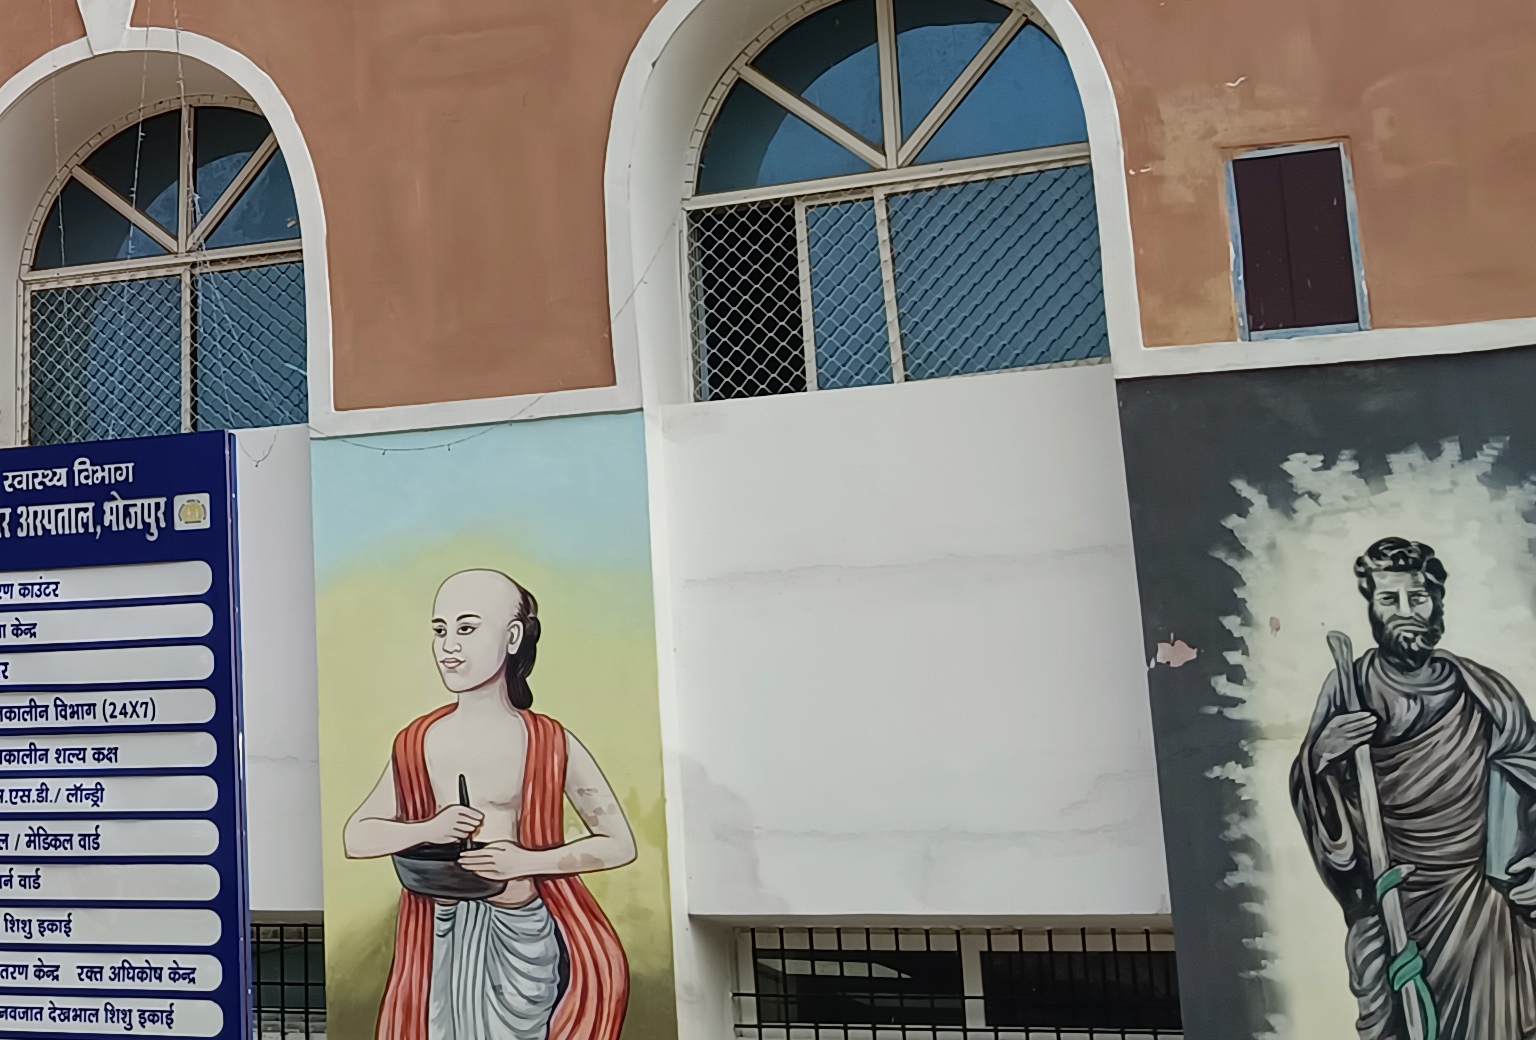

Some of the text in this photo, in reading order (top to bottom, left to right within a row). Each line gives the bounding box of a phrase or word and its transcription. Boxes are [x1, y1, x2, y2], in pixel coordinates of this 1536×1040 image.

[3, 458, 134, 491] स्वास्थ्य विभाग
[18, 576, 60, 598] काउंटर
[11, 617, 37, 638] केन्द्र
[54, 697, 97, 721] विभाग
[103, 697, 155, 722] (24X7)
[55, 748, 87, 764] शल्य
[91, 747, 118, 763] कक्ष
[66, 782, 105, 807] लॉन्ड्री
[25, 826, 74, 850] मेडिकल
[78, 825, 100, 850] वार्ड
[18, 868, 41, 889] वार्ड
[4, 913, 32, 939] शिशु
[36, 913, 72, 937] इकाई
[33, 958, 60, 981] केन्द्र
[76, 966, 104, 981] रक्त
[109, 959, 163, 982] अधिकोष
[168, 960, 196, 984] केन्द्र
[48, 1000, 100, 1023] देखभाल
[104, 1002, 133, 1031] शिशु
[137, 1003, 174, 1029] इकाई
